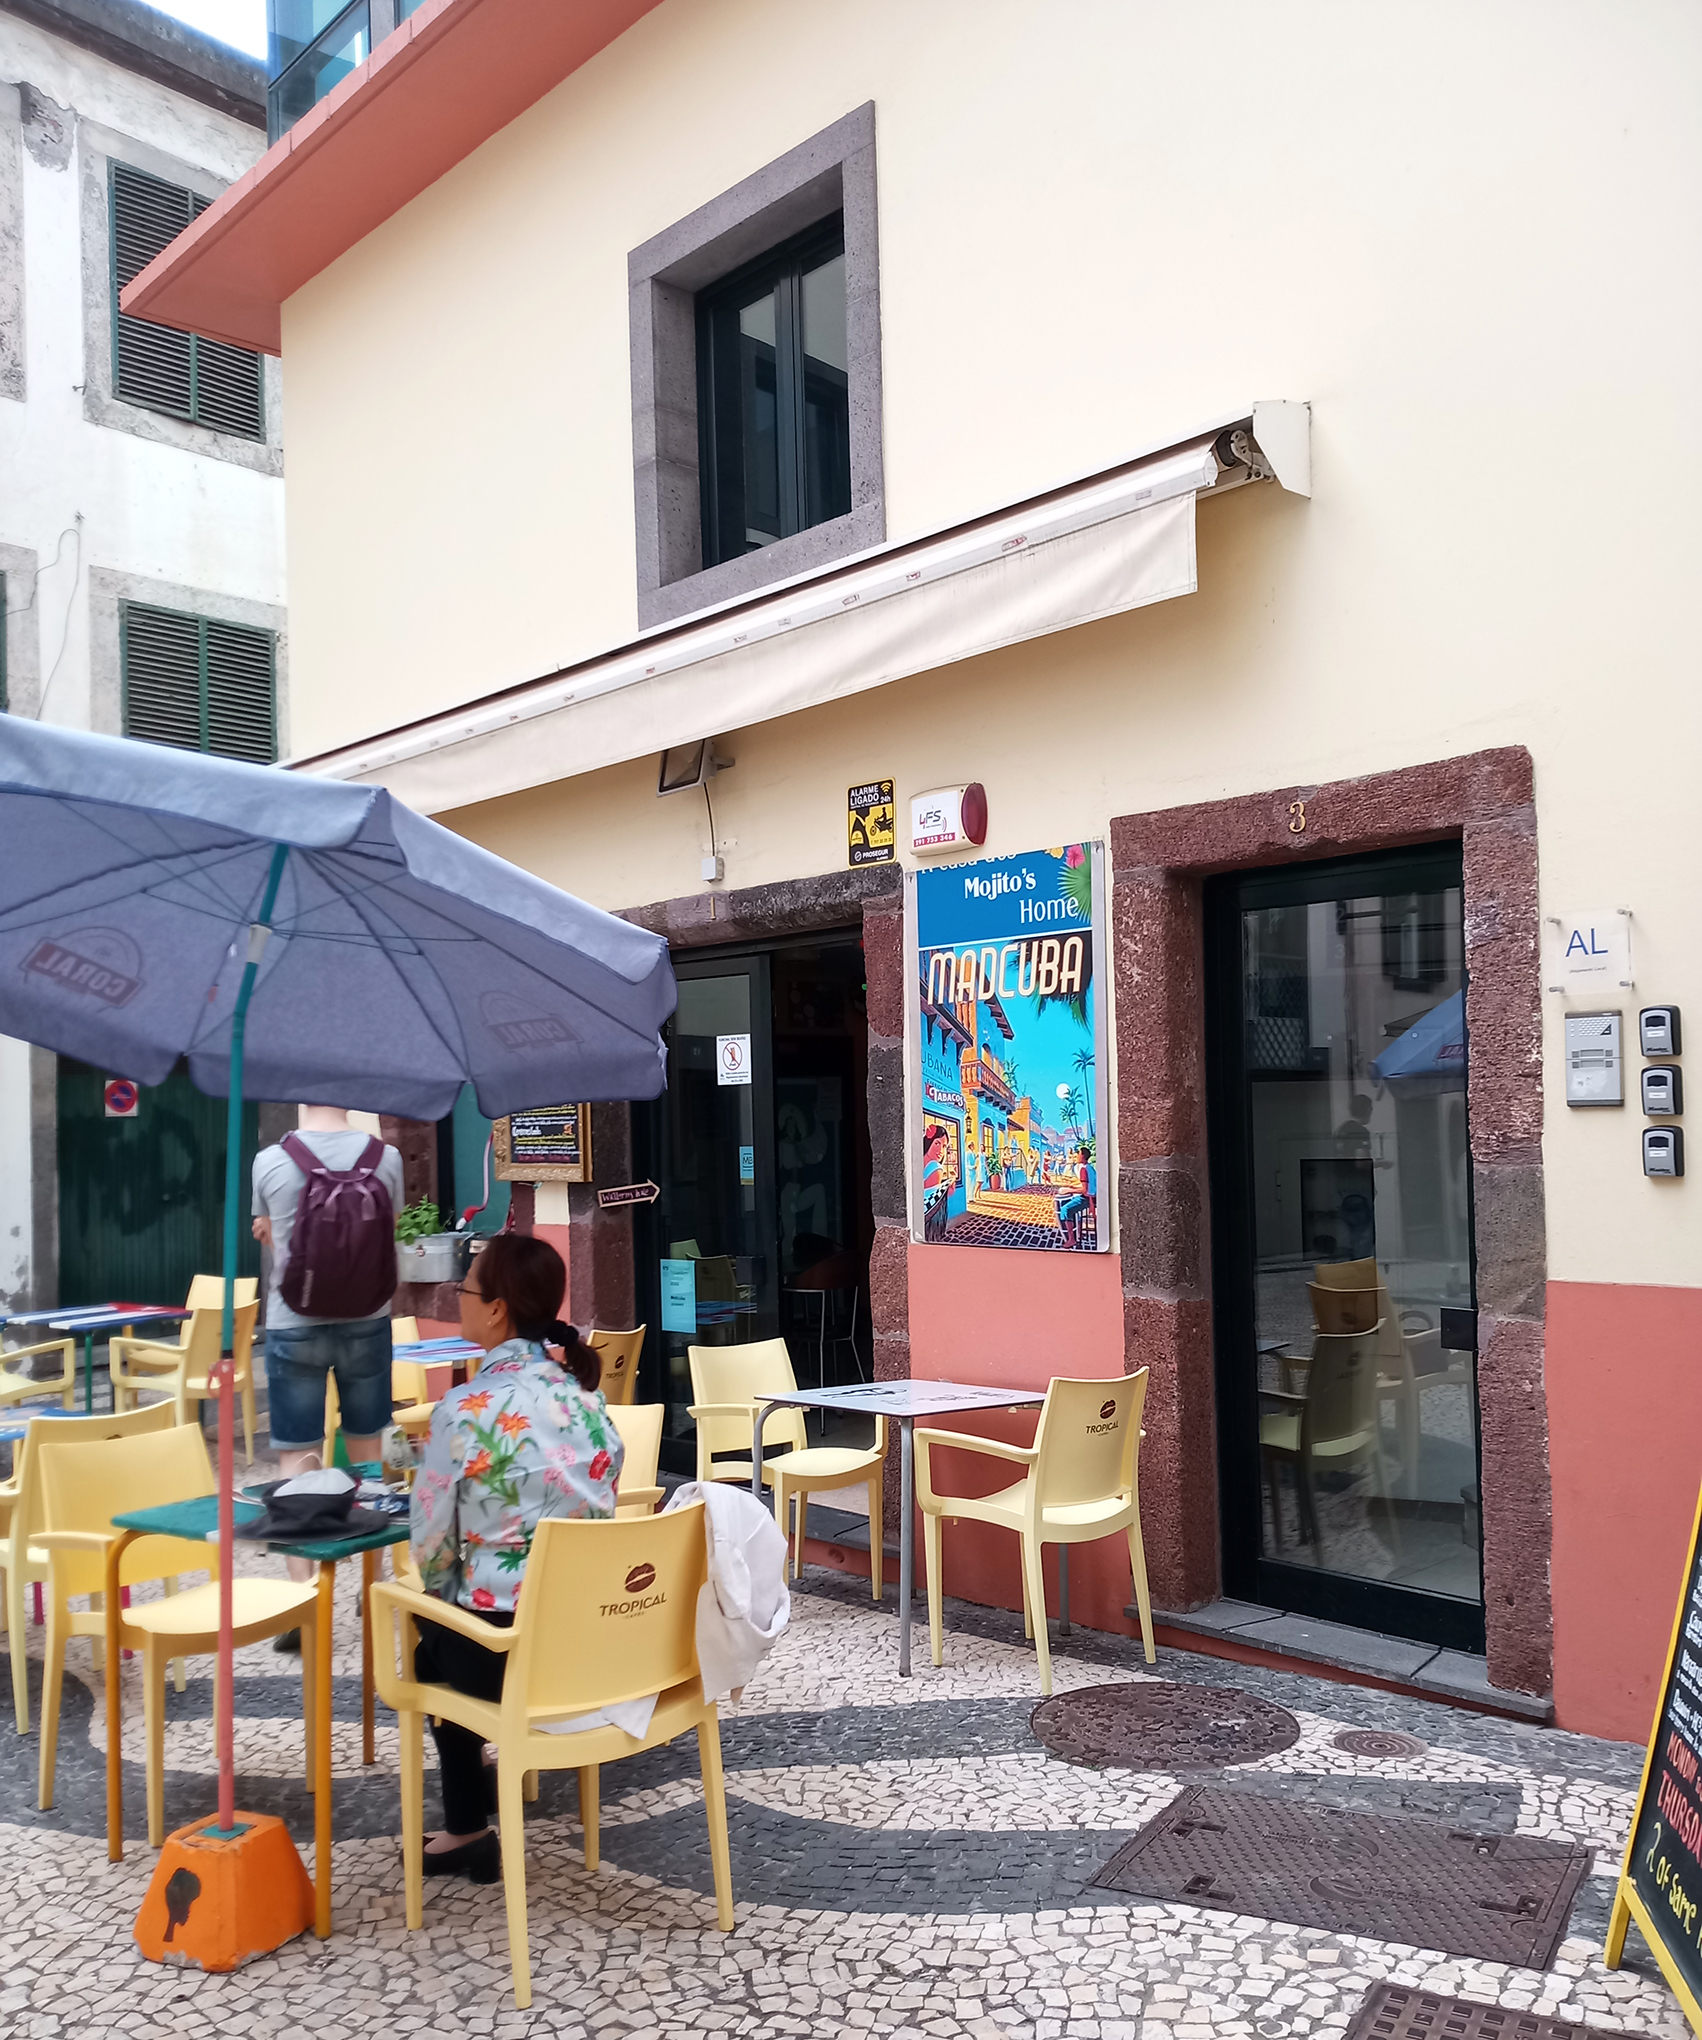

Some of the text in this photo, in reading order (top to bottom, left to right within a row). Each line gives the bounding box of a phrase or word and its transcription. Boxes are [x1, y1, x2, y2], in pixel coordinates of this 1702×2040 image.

[850, 784, 879, 798] ALARME
[850, 792, 880, 806] LIGADO
[880, 795, 891, 804] 24h
[1289, 801, 1306, 833] 3
[926, 836, 939, 844] 753
[940, 833, 954, 842] 346
[862, 848, 889, 859] PROSEGUR
[964, 868, 1037, 900] Mojito's
[1019, 896, 1079, 924] Home
[1565, 927, 1609, 958] AL
[927, 936, 1084, 1006] MADCUBA
[929, 1087, 965, 1108] TABACOS
[1085, 1420, 1119, 1435] TROPICAL
[599, 1592, 668, 1618] TROPICAL
[1657, 1769, 1702, 1870] THURSDA
